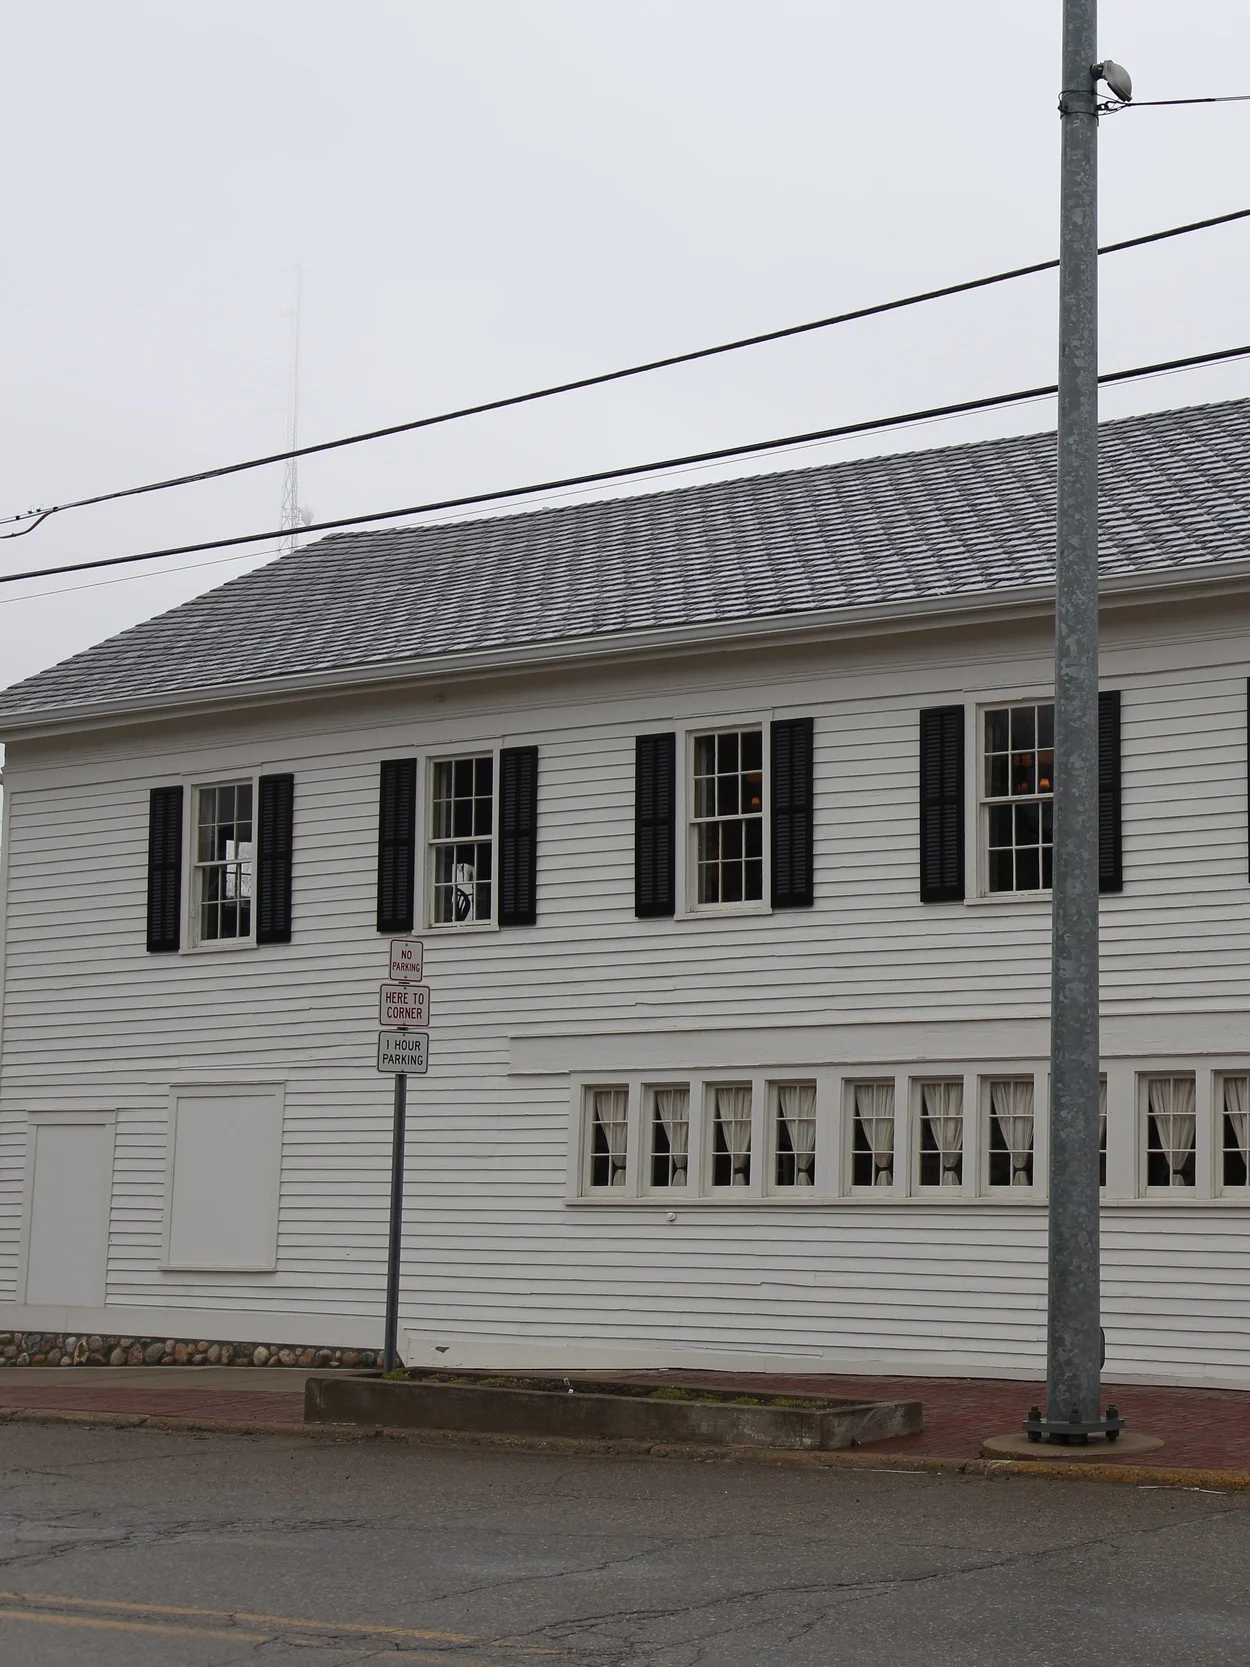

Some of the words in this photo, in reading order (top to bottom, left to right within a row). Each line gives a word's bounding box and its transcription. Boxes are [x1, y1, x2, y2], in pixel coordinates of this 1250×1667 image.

[401, 950, 412, 960] NO
[392, 962, 421, 973] PARKING
[385, 992, 409, 1004] HERE
[413, 993, 425, 1005] TO
[386, 1007, 423, 1020] CORNER
[394, 1040, 421, 1052] HOUR
[382, 1053, 423, 1066] PARKING
